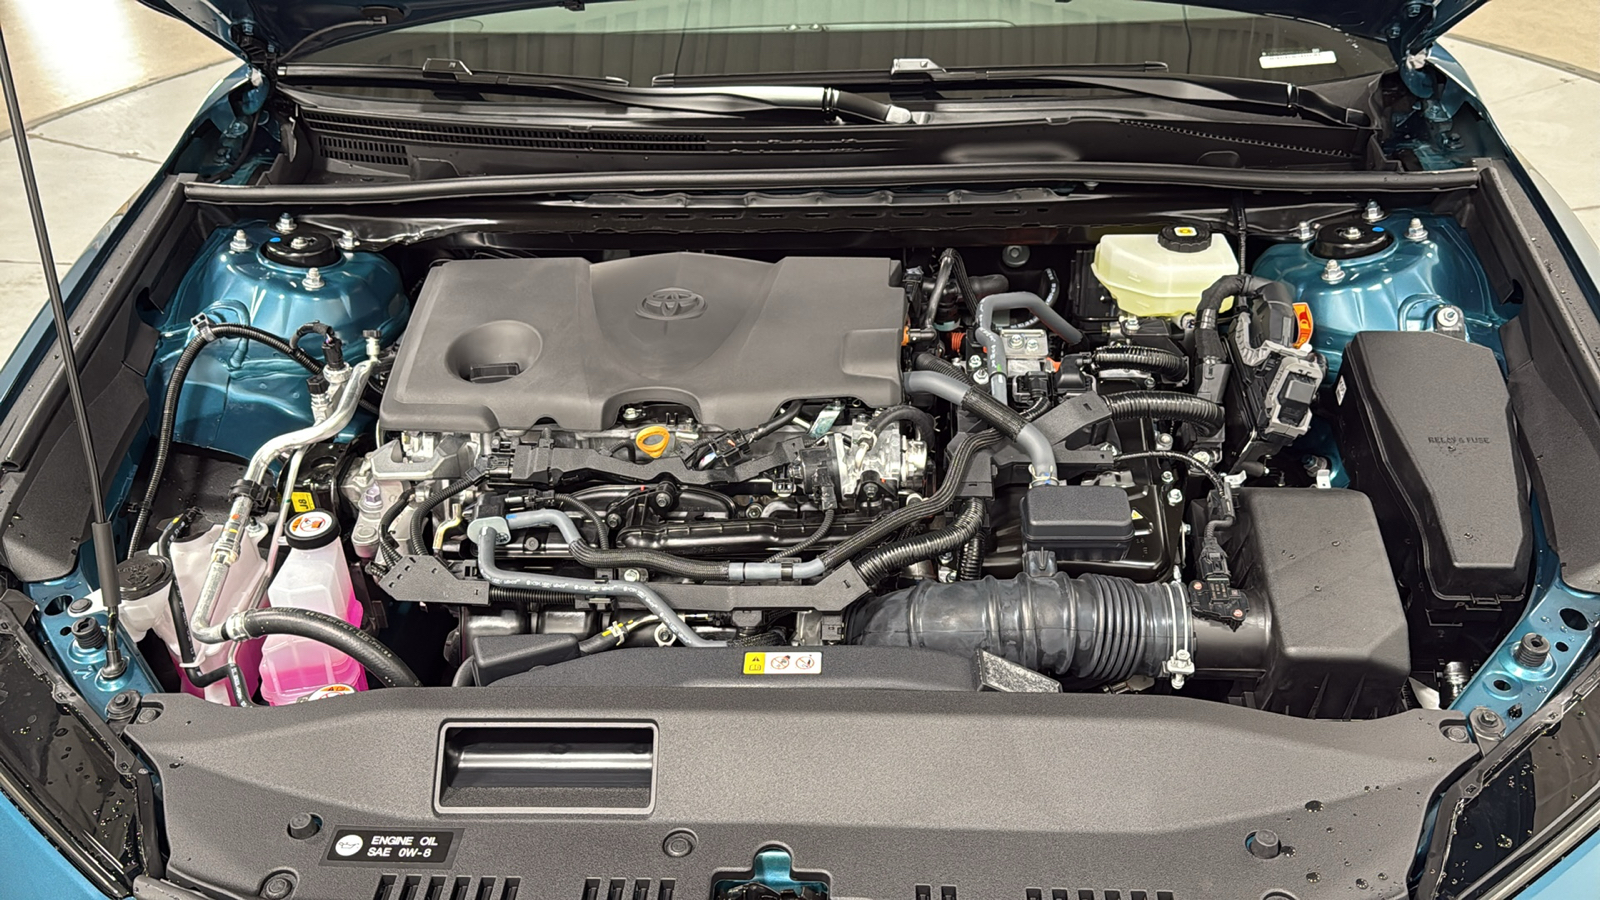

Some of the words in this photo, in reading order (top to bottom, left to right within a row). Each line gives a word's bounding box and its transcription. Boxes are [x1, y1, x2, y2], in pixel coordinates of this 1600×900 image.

[1466, 436, 1490, 444] FUSE
[371, 835, 414, 846] ENGINE
[419, 836, 438, 847] OIL
[367, 846, 392, 857] SAE
[398, 847, 432, 858] 0W-8
